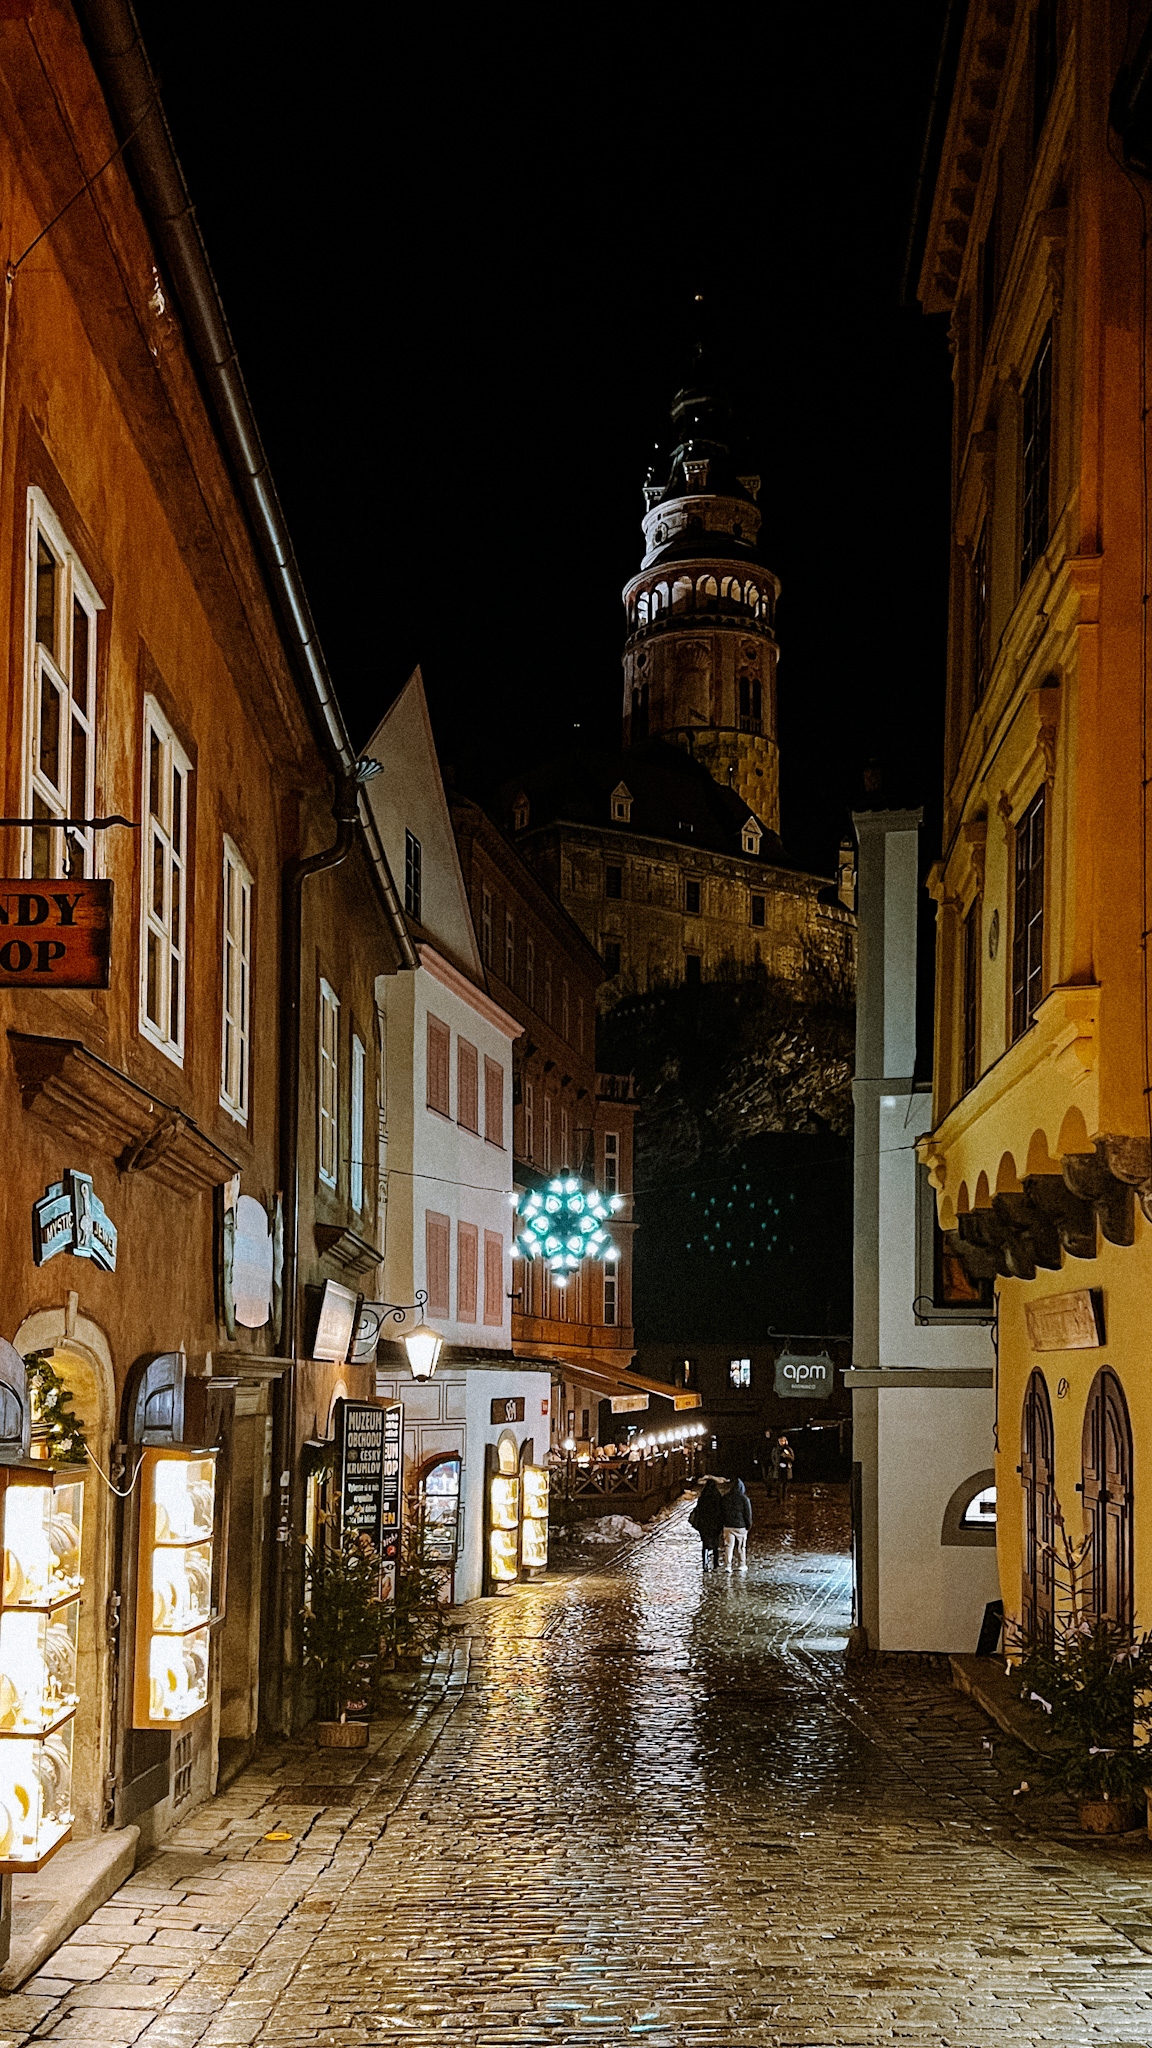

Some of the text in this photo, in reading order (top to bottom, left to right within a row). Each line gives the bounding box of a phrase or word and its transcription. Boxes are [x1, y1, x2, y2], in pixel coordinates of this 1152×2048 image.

[0, 940, 66, 972] OP
[44, 1211, 74, 1243] MYSTIC
[783, 1364, 826, 1383] apm
[348, 1411, 383, 1431] MUZEUM
[347, 1432, 382, 1448] OBCHODU
[346, 1461, 381, 1475] KRUMLOV
